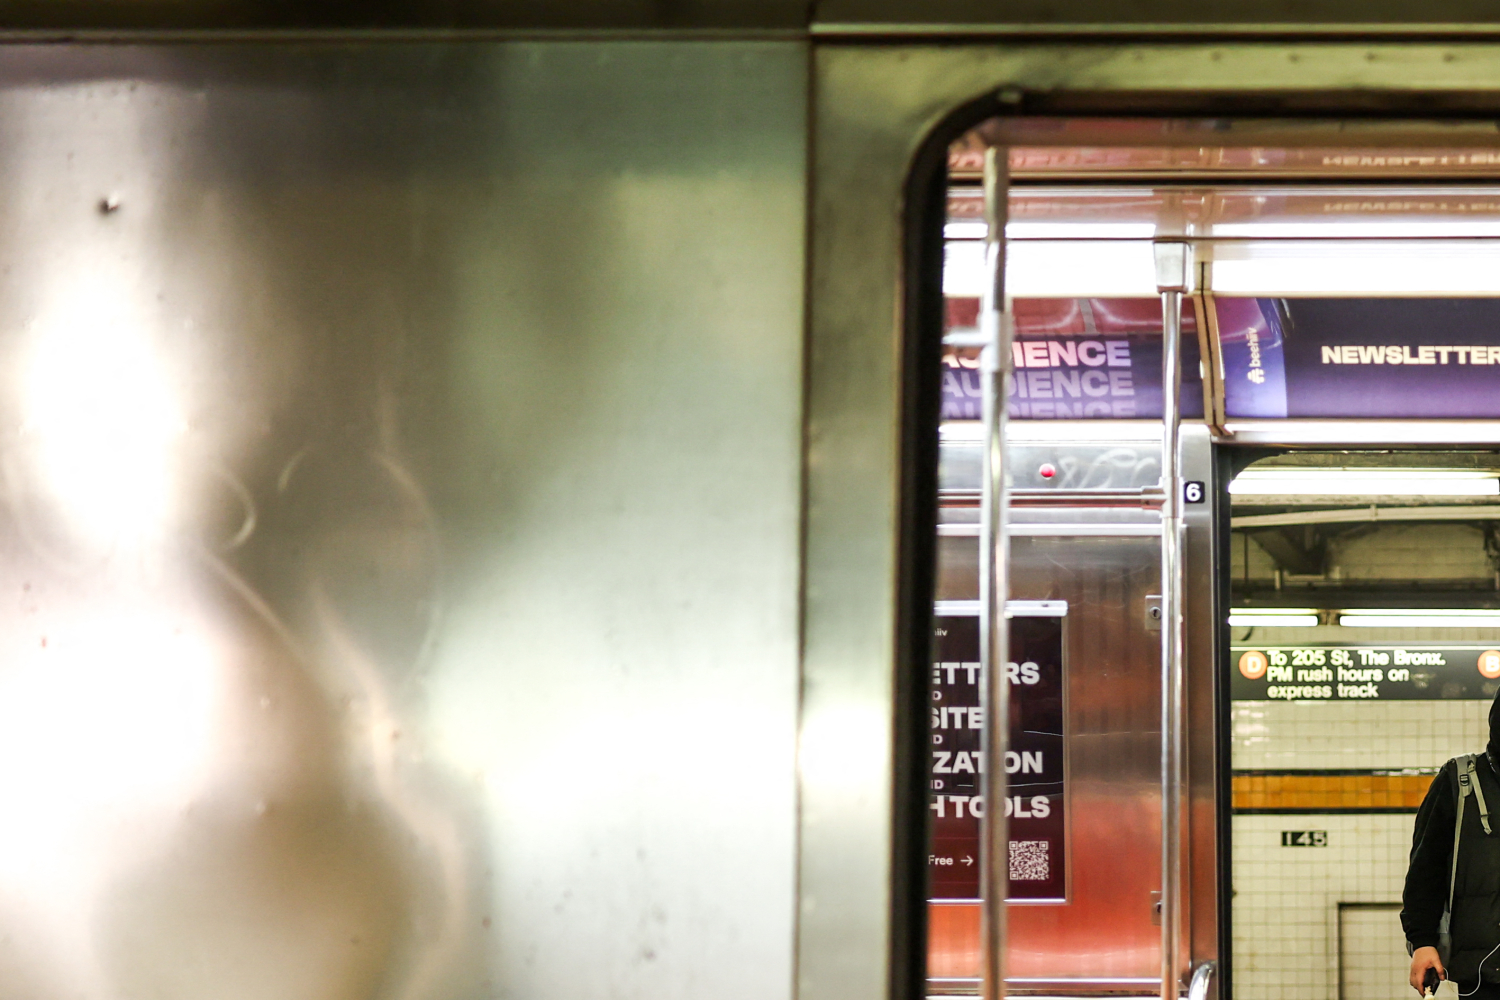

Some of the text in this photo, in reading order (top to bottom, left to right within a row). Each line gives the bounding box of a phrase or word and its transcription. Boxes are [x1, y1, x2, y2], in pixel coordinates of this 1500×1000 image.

[1186, 483, 1201, 502] 6
[1267, 650, 1447, 667] To 205 St, The Bronx.
[1266, 666, 1411, 683] PM rush hours on
[1267, 683, 1379, 700] express track
[1286, 831, 1326, 846] 145
